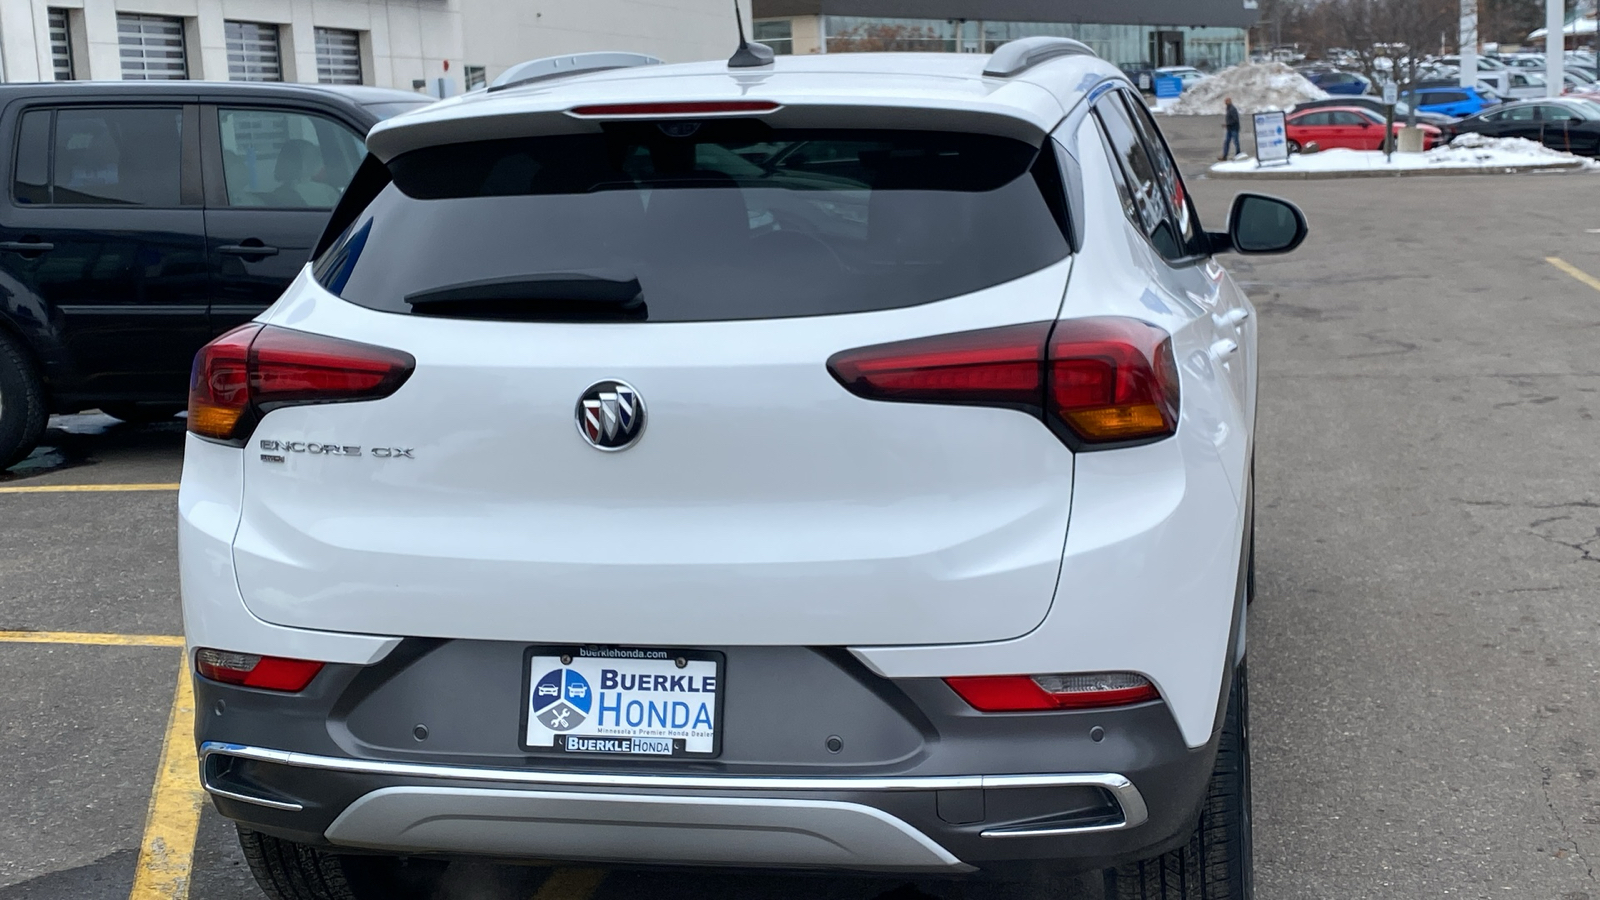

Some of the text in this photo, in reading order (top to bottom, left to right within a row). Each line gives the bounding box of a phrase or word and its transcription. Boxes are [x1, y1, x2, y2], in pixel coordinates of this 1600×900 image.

[260, 440, 415, 459] ENCORE GX
[580, 648, 667, 659] buerklehonda.com
[600, 669, 716, 693] BUERKLE
[597, 692, 713, 730] HONDA
